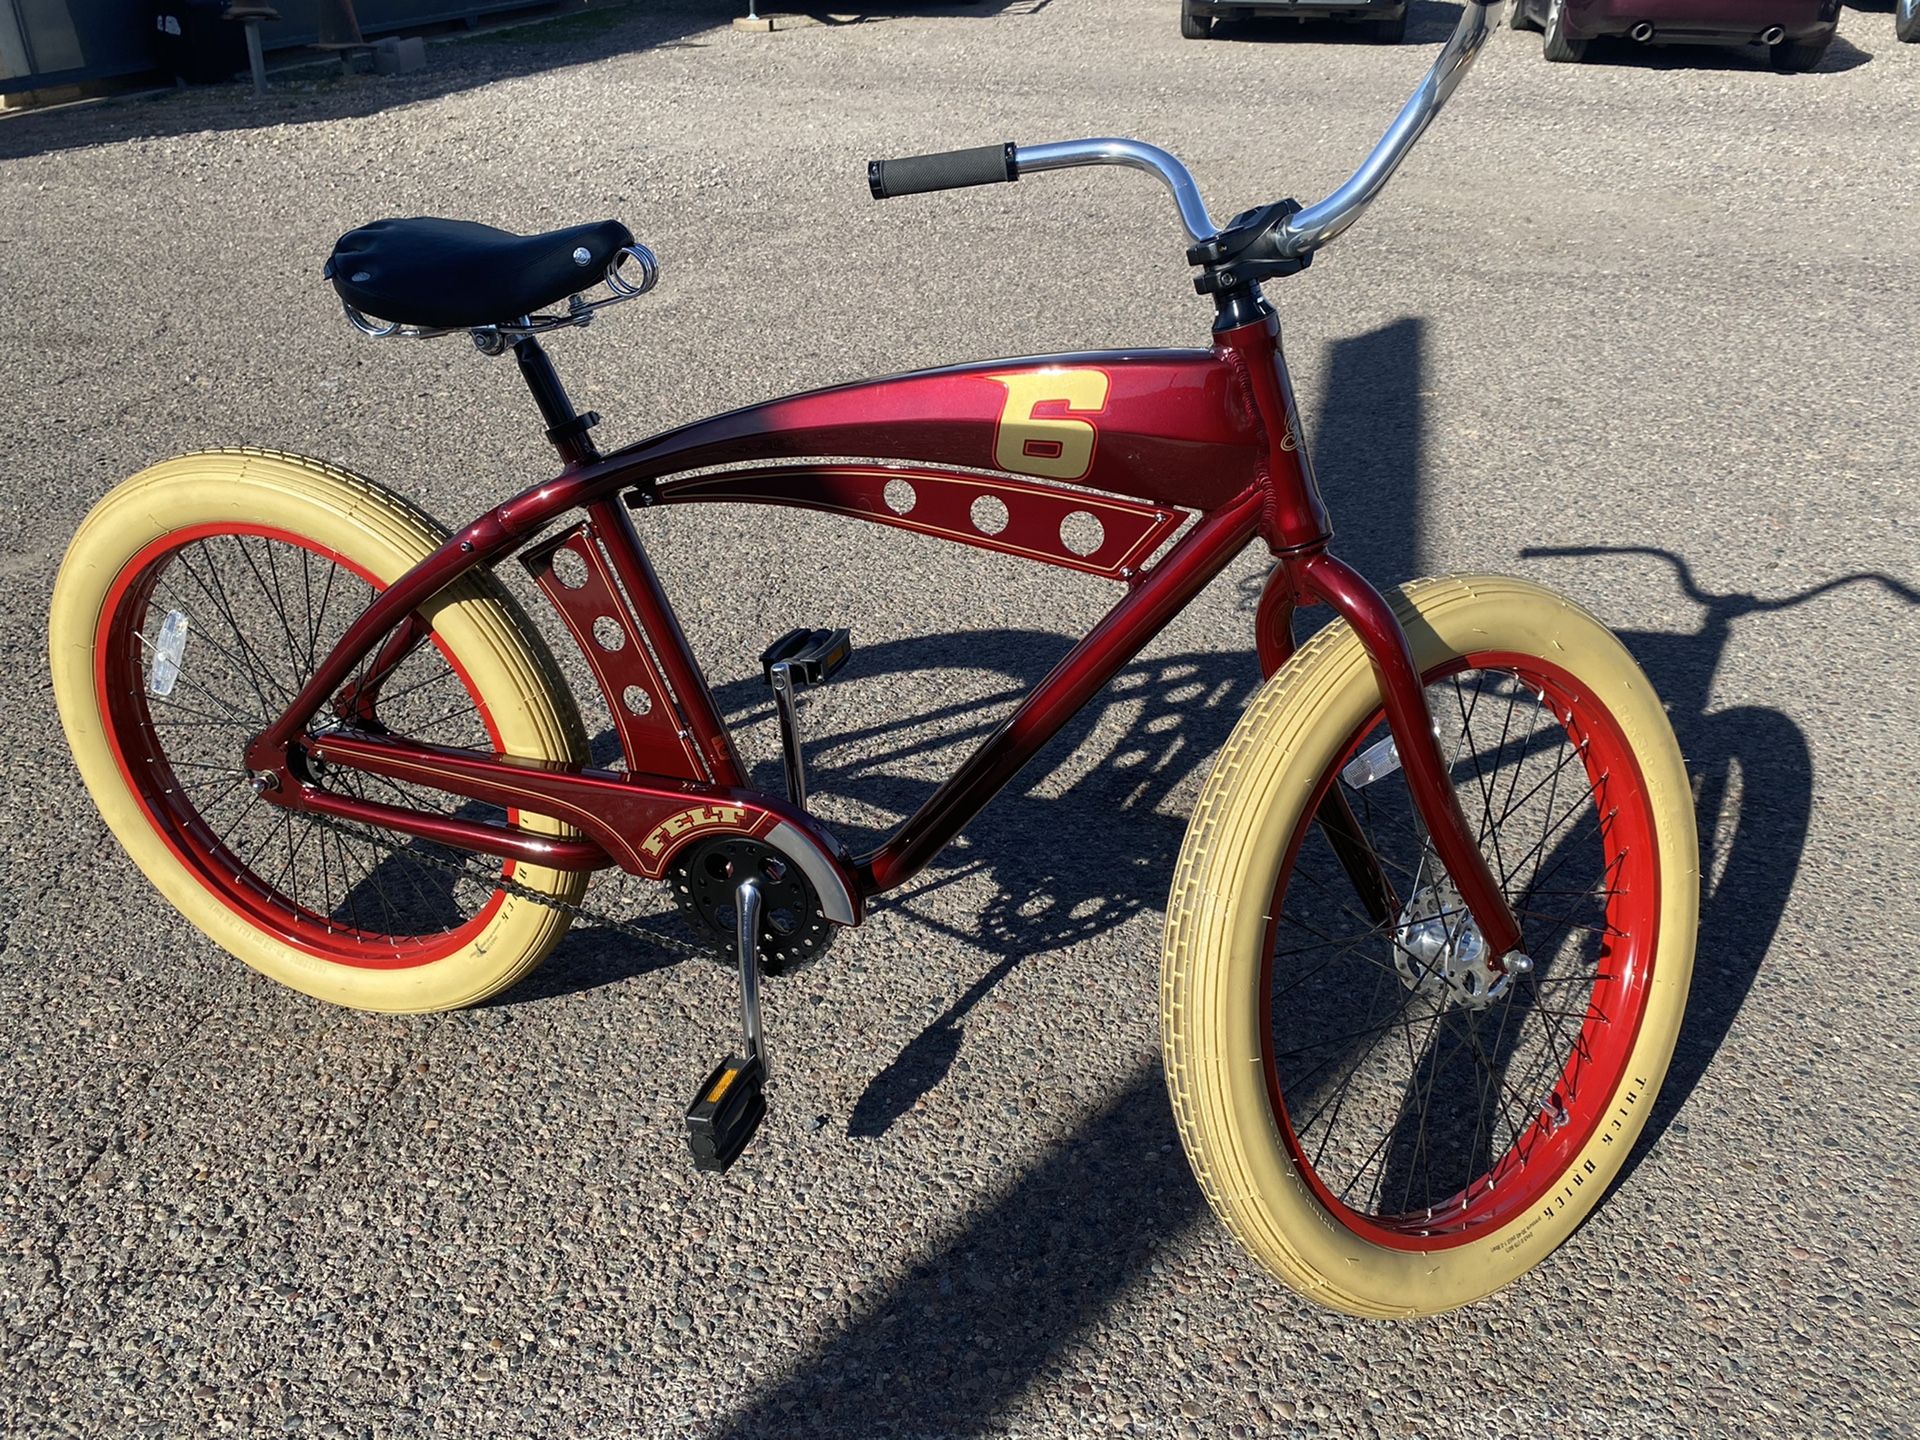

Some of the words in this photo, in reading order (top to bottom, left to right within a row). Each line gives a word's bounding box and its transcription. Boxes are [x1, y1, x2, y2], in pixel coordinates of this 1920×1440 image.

[980, 367, 1110, 481] 6
[640, 805, 746, 857] FELT
[1602, 1076, 1647, 1146] THICK
[1543, 1159, 1597, 1220] BRICK
